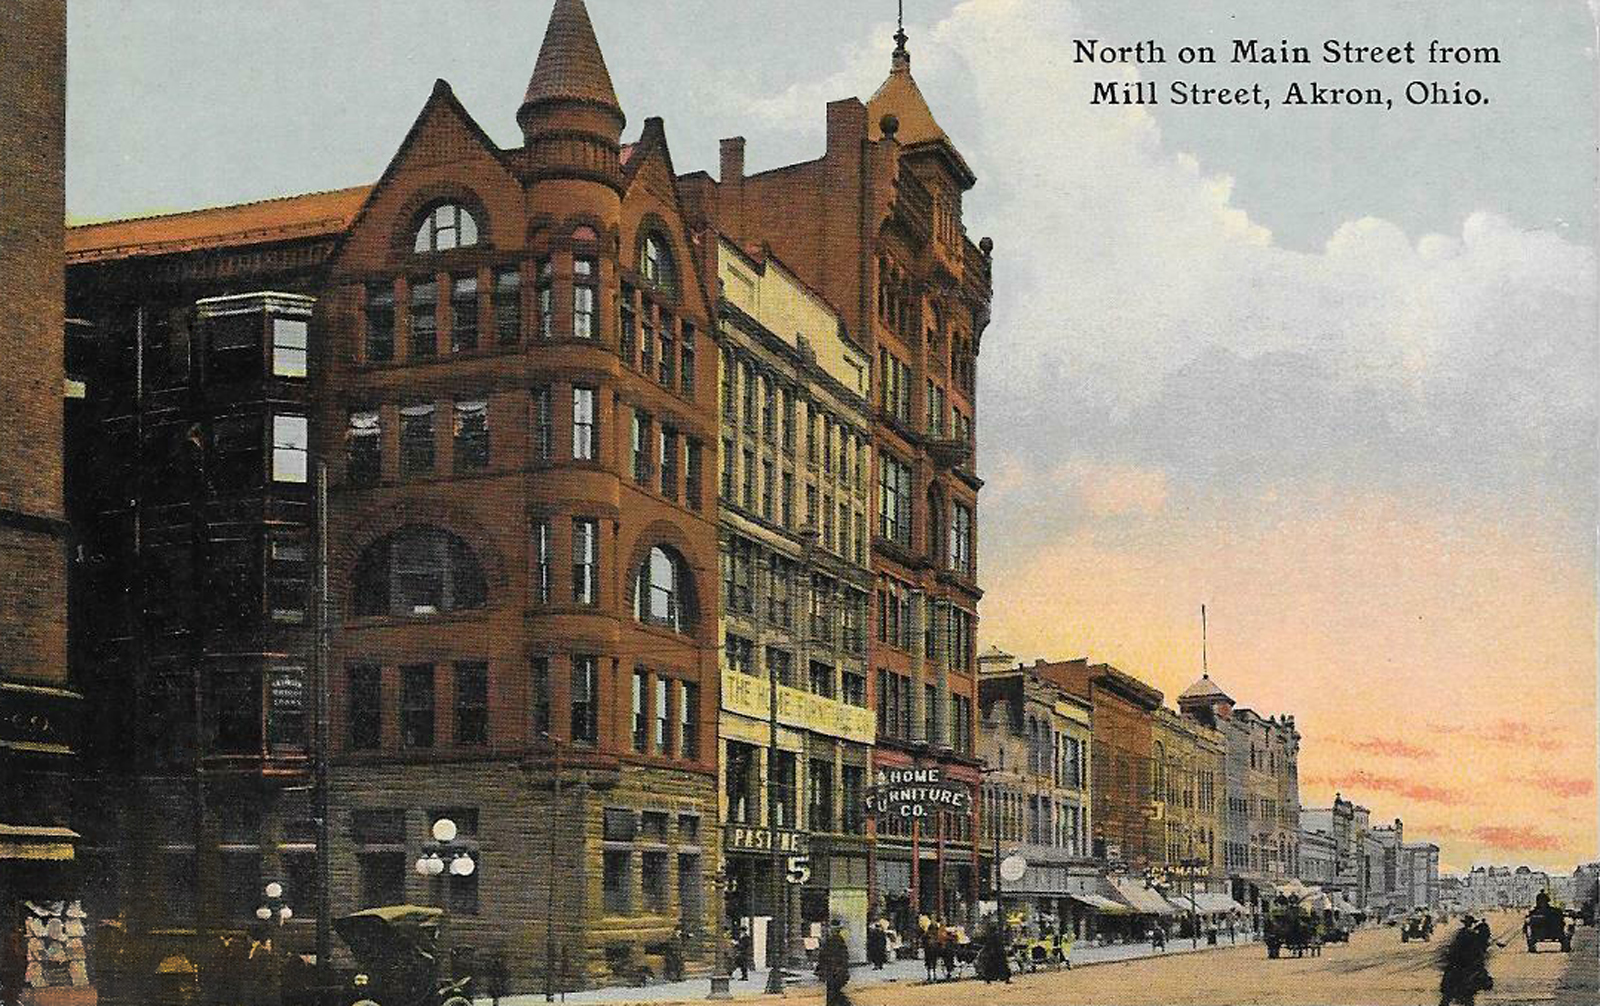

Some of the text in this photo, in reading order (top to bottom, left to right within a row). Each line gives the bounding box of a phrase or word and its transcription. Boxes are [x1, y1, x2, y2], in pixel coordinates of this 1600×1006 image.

[890, 769, 940, 783] HOME
[865, 787, 965, 813] FURNITURE
[900, 803, 929, 818] CO.
[734, 828, 800, 852] PASTME
[786, 855, 811, 885] 5
